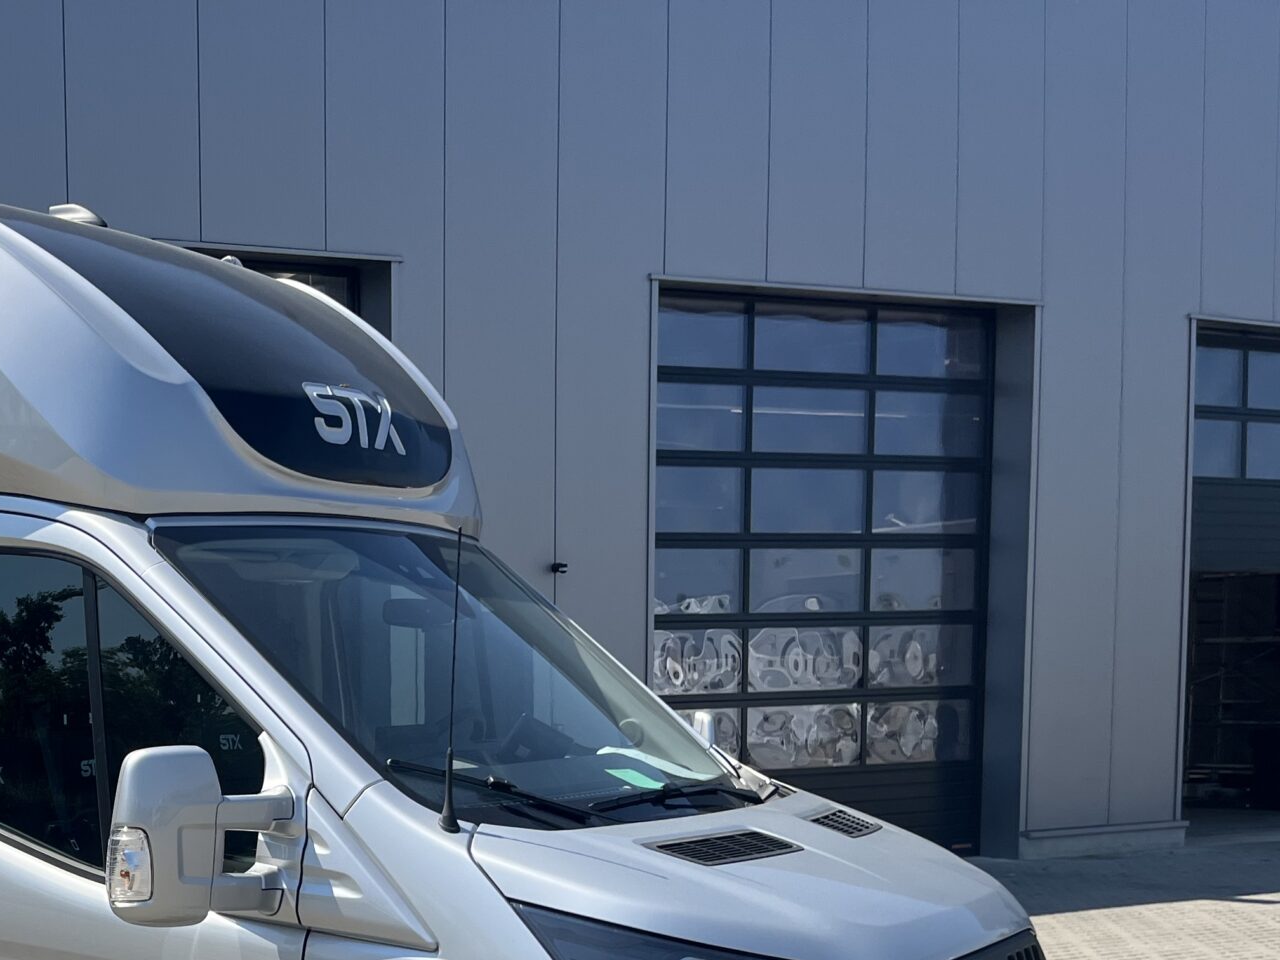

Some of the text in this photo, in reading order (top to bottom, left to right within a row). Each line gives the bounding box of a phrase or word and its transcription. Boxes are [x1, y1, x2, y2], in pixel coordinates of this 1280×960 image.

[301, 381, 407, 456] STX
[219, 733, 242, 750] STX
[80, 759, 96, 777] ST
